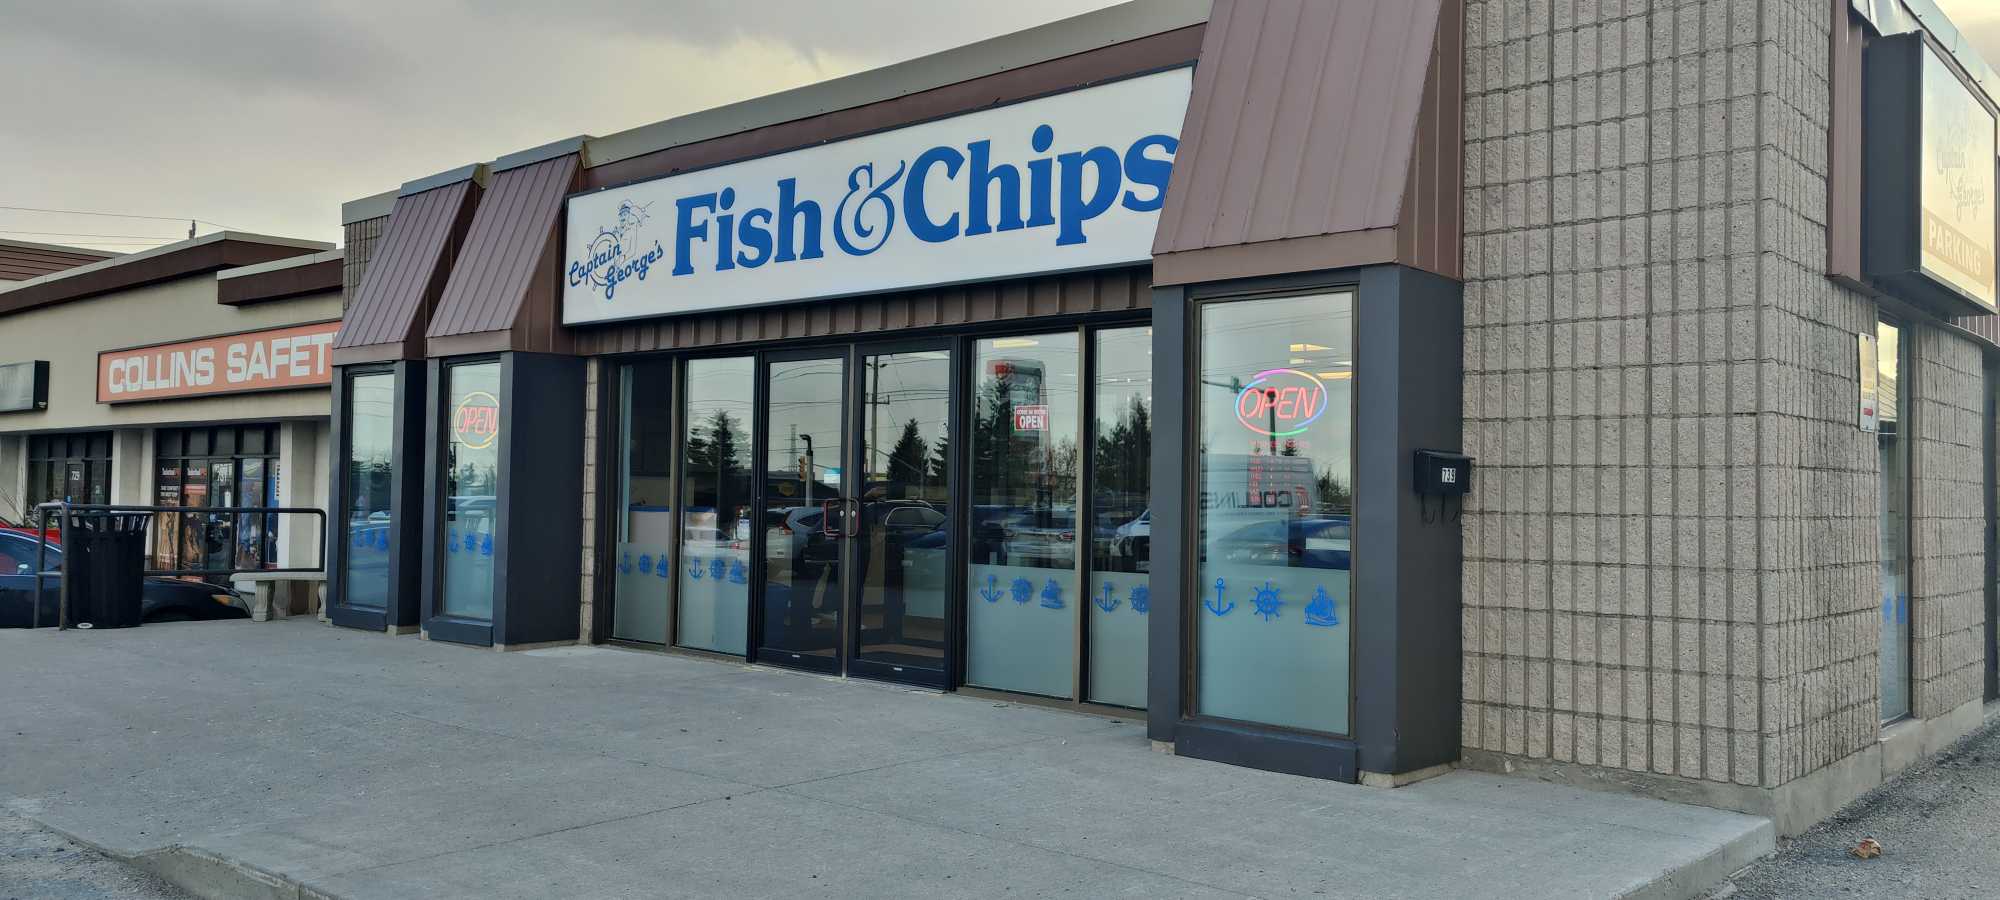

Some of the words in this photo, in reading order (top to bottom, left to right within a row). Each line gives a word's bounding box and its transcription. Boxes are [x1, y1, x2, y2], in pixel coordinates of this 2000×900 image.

[671, 176, 824, 276] Fish
[832, 160, 906, 256] &
[903, 124, 1179, 247] Chips
[568, 243, 622, 287] Captain
[604, 239, 664, 300] George's
[1928, 216, 1982, 276] PARKING
[108, 347, 215, 394] COLLINS
[226, 332, 337, 384] SAFET
[457, 407, 498, 433] OPEN
[1019, 415, 1044, 429] OPEN
[1240, 386, 1320, 419] OPEN
